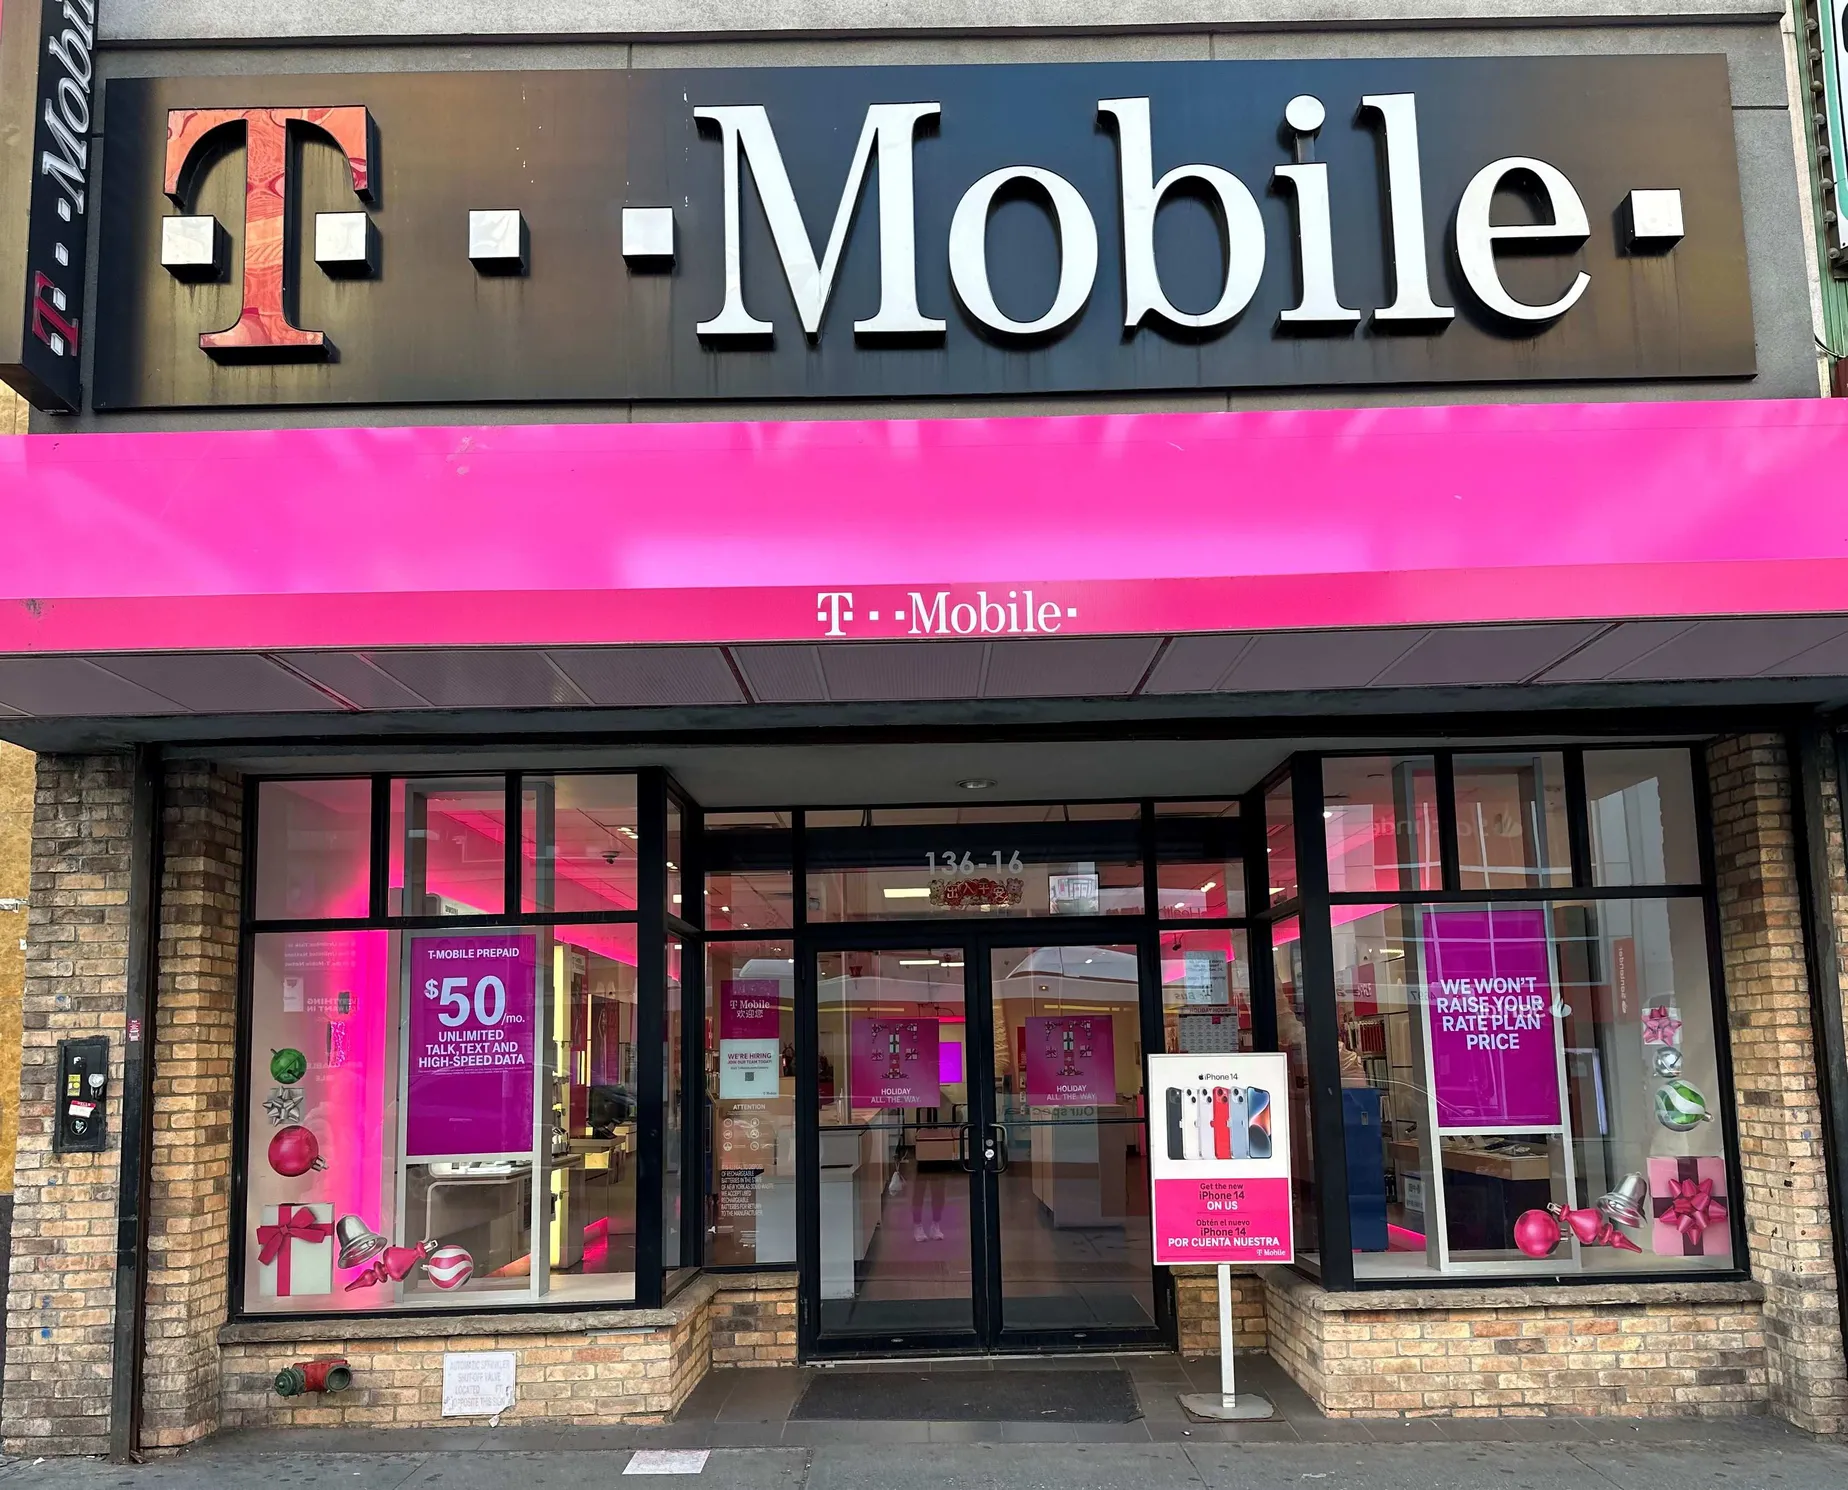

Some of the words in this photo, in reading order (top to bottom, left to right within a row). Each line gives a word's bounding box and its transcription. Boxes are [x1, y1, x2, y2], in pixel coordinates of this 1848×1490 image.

[692, 92, 1592, 337] Mobile
[907, 590, 1062, 634] Mobile
[925, 850, 1024, 875] 136-16
[946, 882, 1008, 900] 出入平安
[427, 949, 475, 960] T-MOBILE
[476, 947, 520, 958] PREPAID
[1440, 978, 1472, 995] WE
[1474, 977, 1537, 994] WON'T
[739, 999, 770, 1010] Mobile
[1436, 996, 1490, 1013] RAISE
[1492, 995, 1544, 1012] YOUR
[1442, 1015, 1488, 1032] RATE
[1491, 1013, 1541, 1030] PLAN
[438, 1029, 504, 1042] UNLIMITED
[1466, 1033, 1520, 1050] PRICE
[492, 1041, 518, 1053] AND
[418, 1055, 492, 1068] HIGH-SPEED
[494, 1054, 525, 1066] DATA
[1205, 1073, 1230, 1081] iPhone
[1230, 1073, 1238, 1081] 14
[1199, 1191, 1232, 1200] iPhone
[1233, 1191, 1245, 1199] 14
[1207, 1201, 1222, 1210] ON
[1224, 1201, 1238, 1210] US
[1196, 1219, 1219, 1227] Obtén
[1200, 1227, 1233, 1236] iPhone
[1234, 1227, 1246, 1236] 14
[1168, 1238, 1189, 1247] POR
[1191, 1237, 1231, 1247] CUENTA
[1233, 1236, 1280, 1246] NUESTRA
[484, 1371, 501, 1381] VALVE
[454, 1385, 480, 1395] LOCATED
